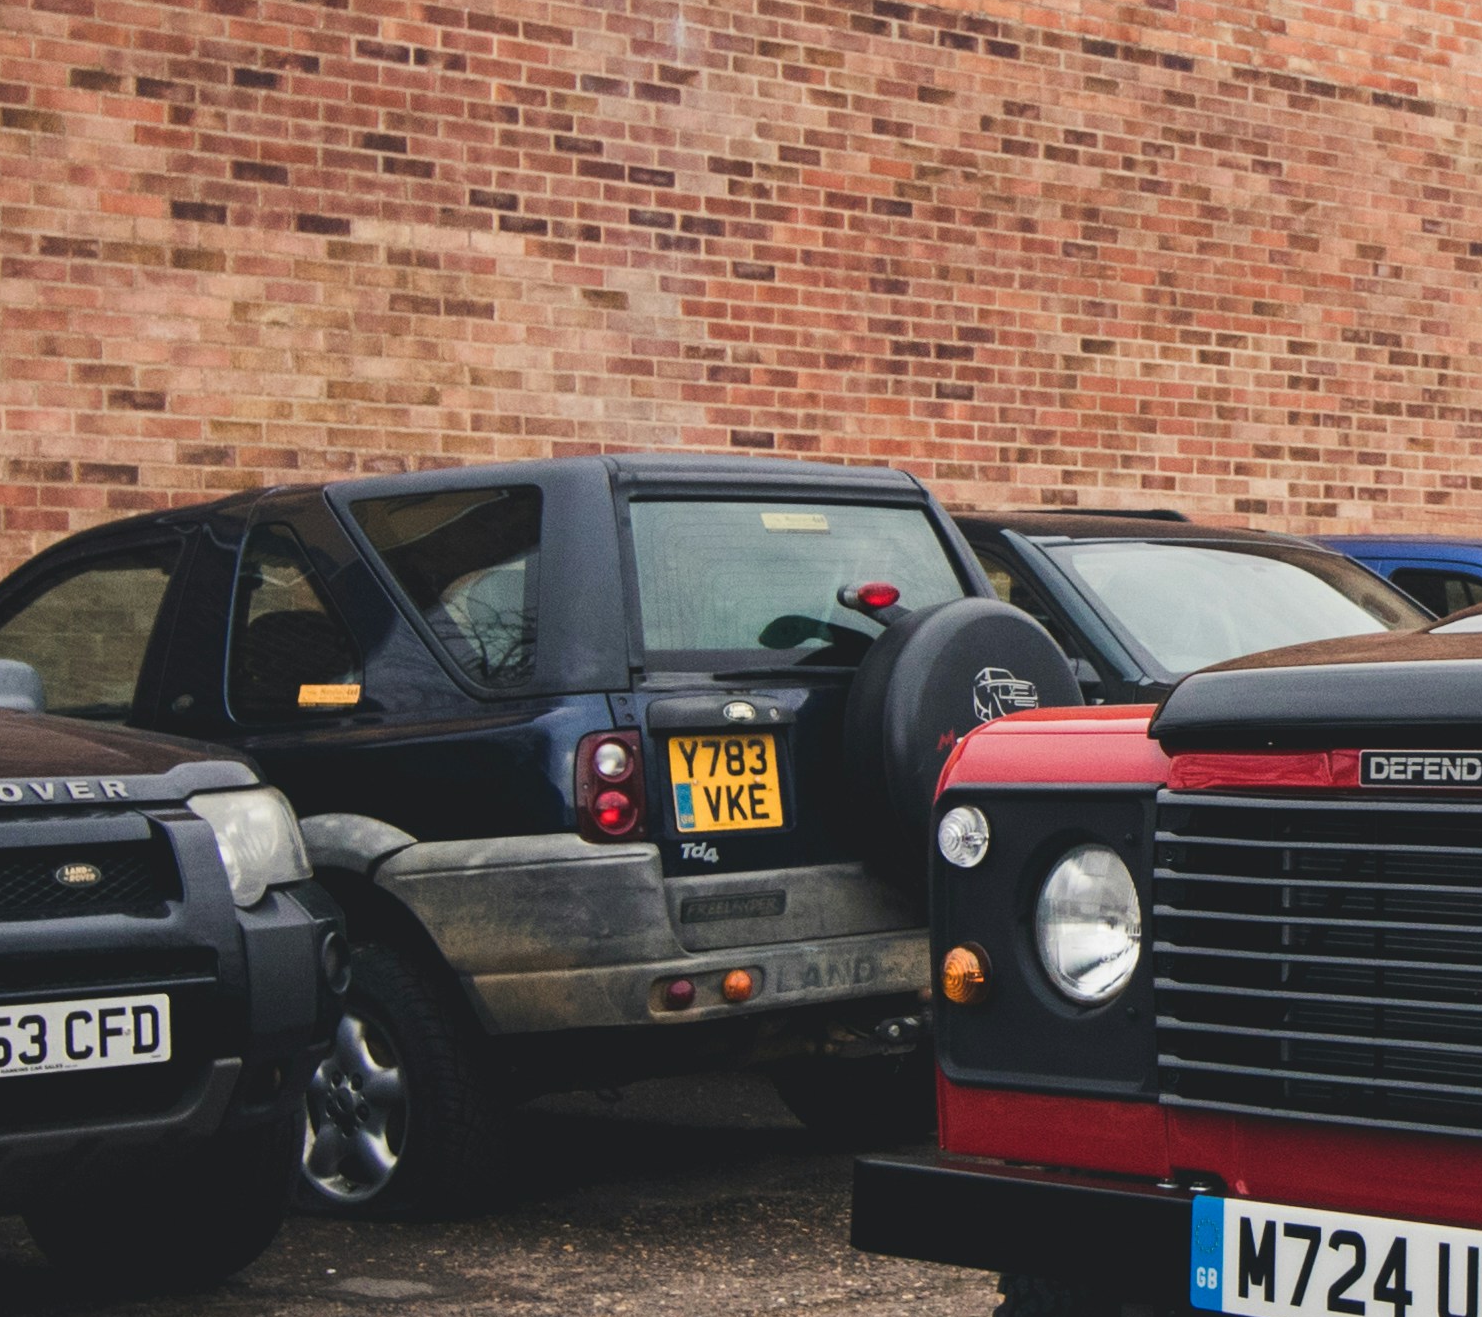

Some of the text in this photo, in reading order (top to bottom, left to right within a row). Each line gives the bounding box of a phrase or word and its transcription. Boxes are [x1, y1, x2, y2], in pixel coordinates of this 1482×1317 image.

[678, 738, 768, 778] Y783
[703, 783, 770, 822] VKE
[681, 842, 719, 864] Td4
[64, 1004, 160, 1061] CFD
[1196, 1266, 1218, 1290] GB
